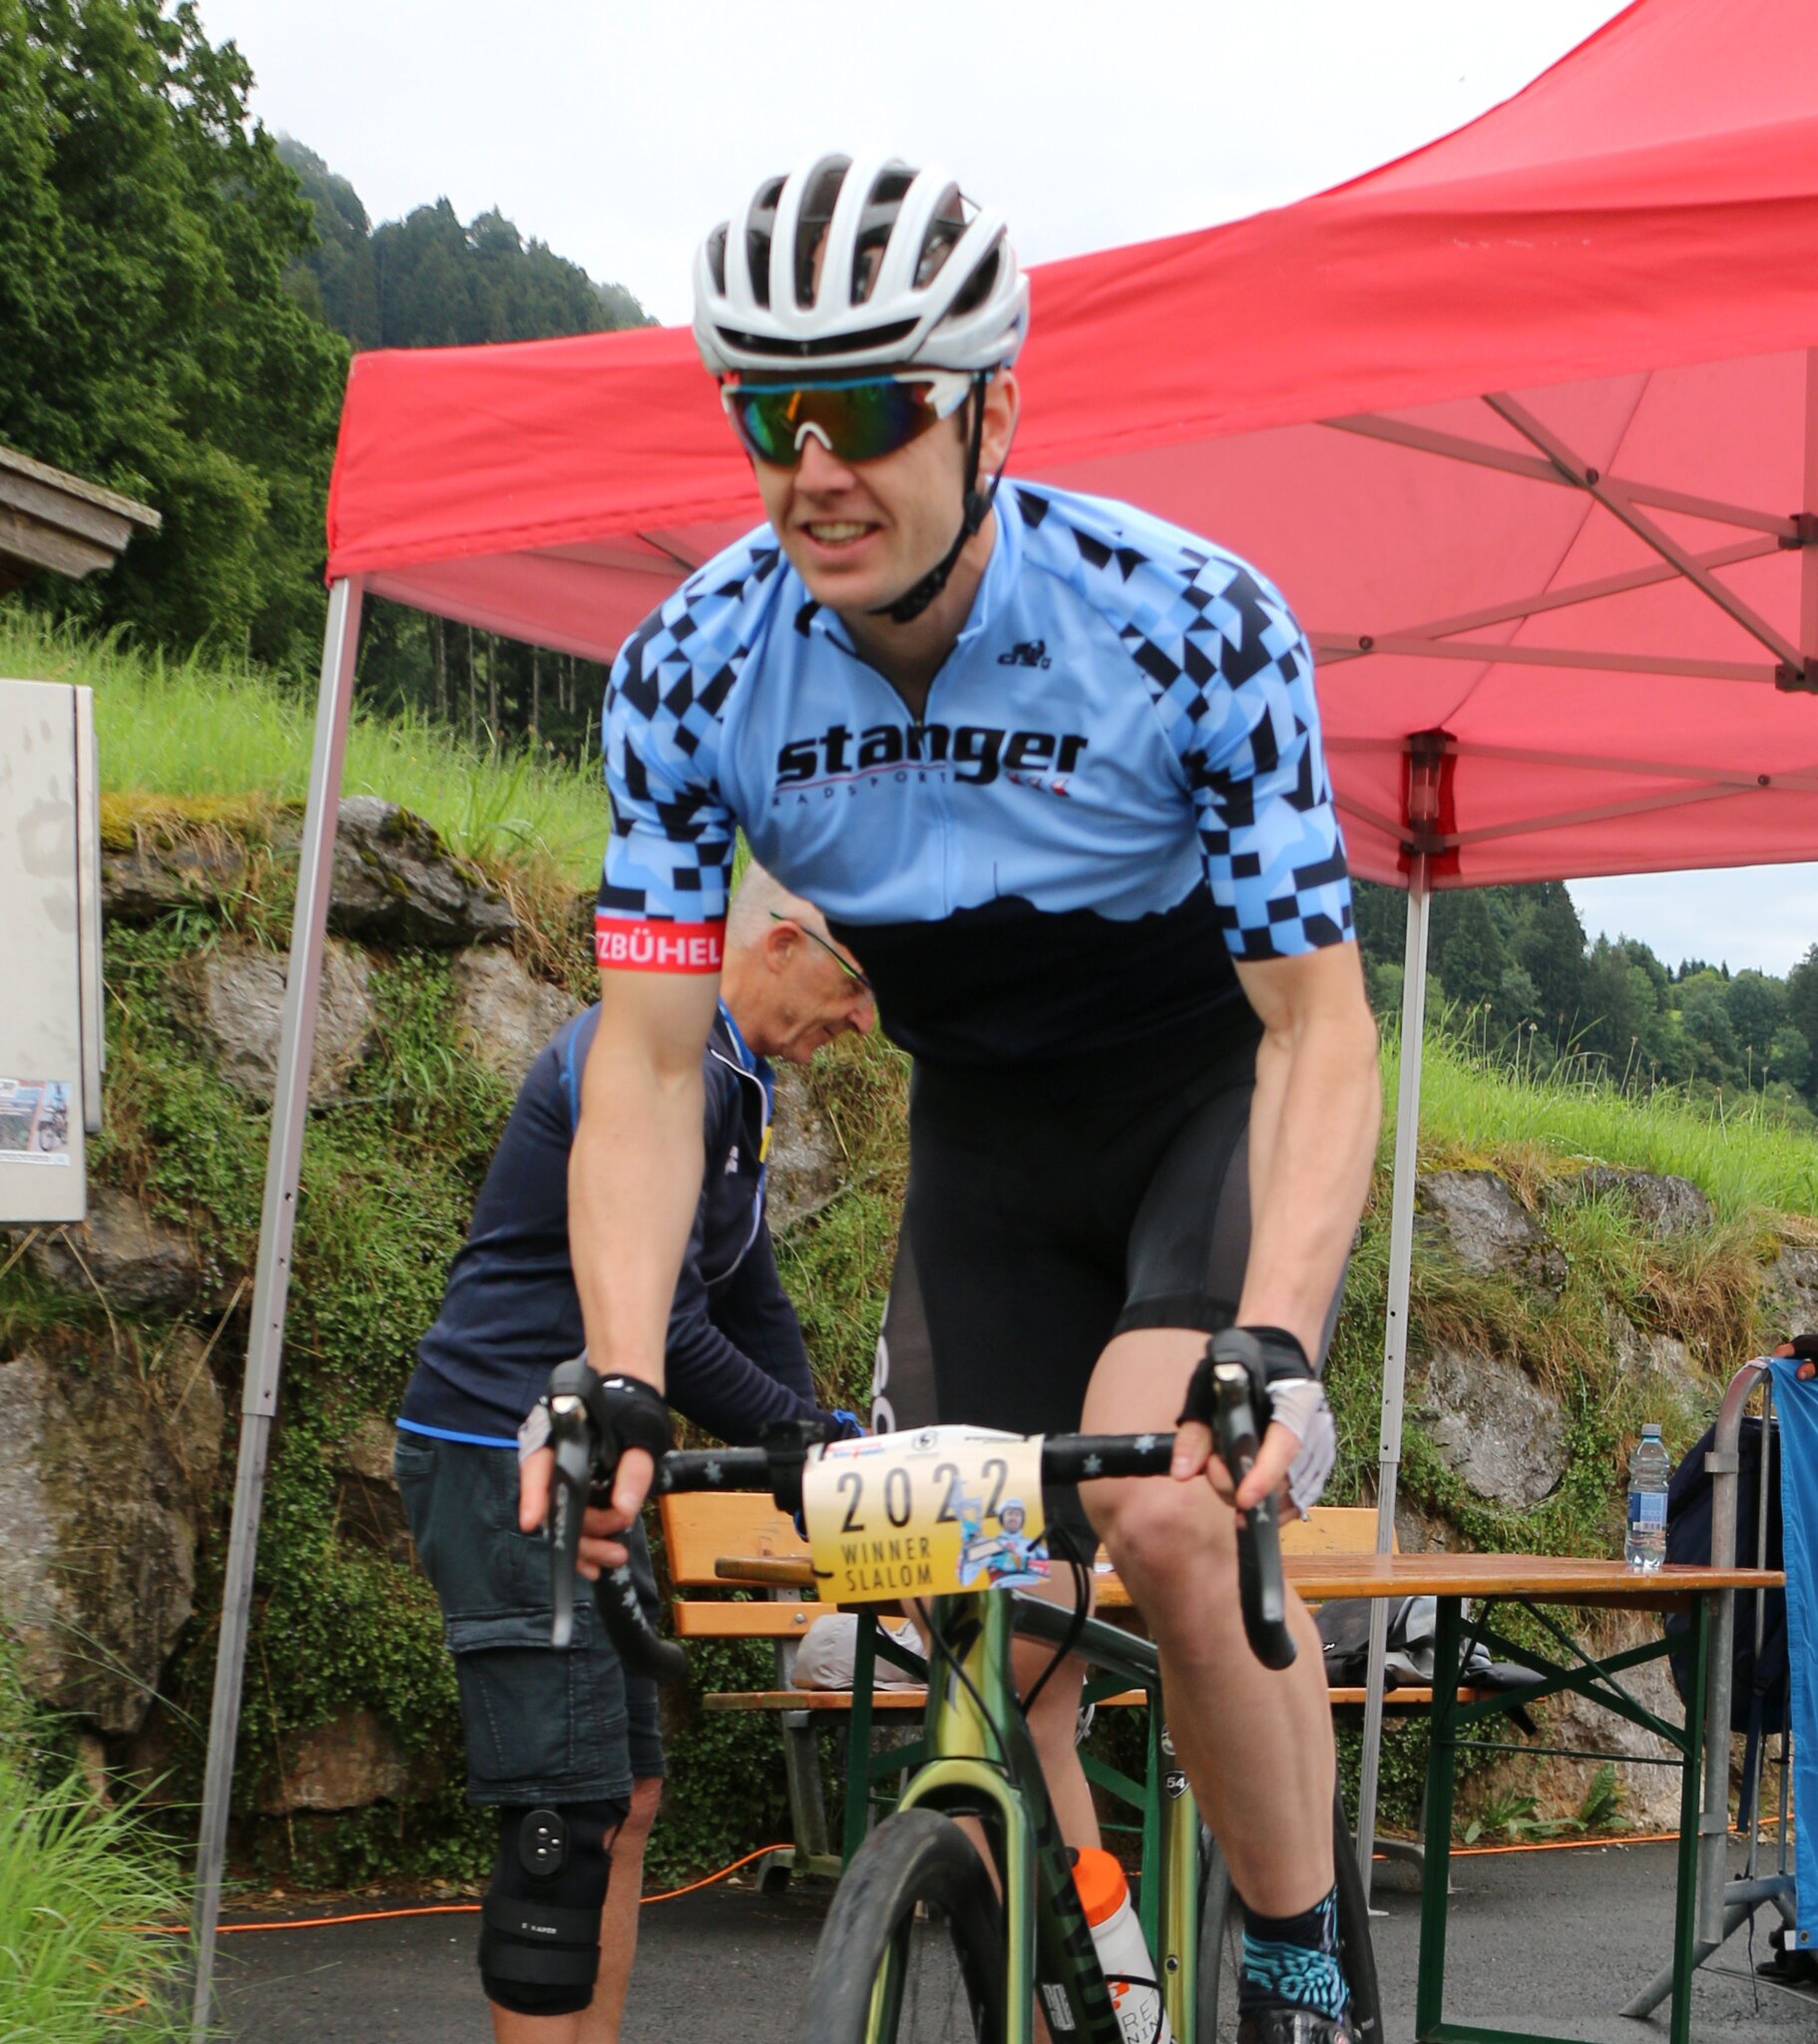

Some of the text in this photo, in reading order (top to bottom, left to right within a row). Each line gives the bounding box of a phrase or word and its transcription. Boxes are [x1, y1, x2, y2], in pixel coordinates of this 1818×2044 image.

[775, 723, 1089, 785] stanger
[837, 1458, 1008, 1533] 2022
[841, 1537, 931, 1565] WINNER
[846, 1564, 933, 1592] SLALOM
[1166, 1777, 1185, 1789] 54
